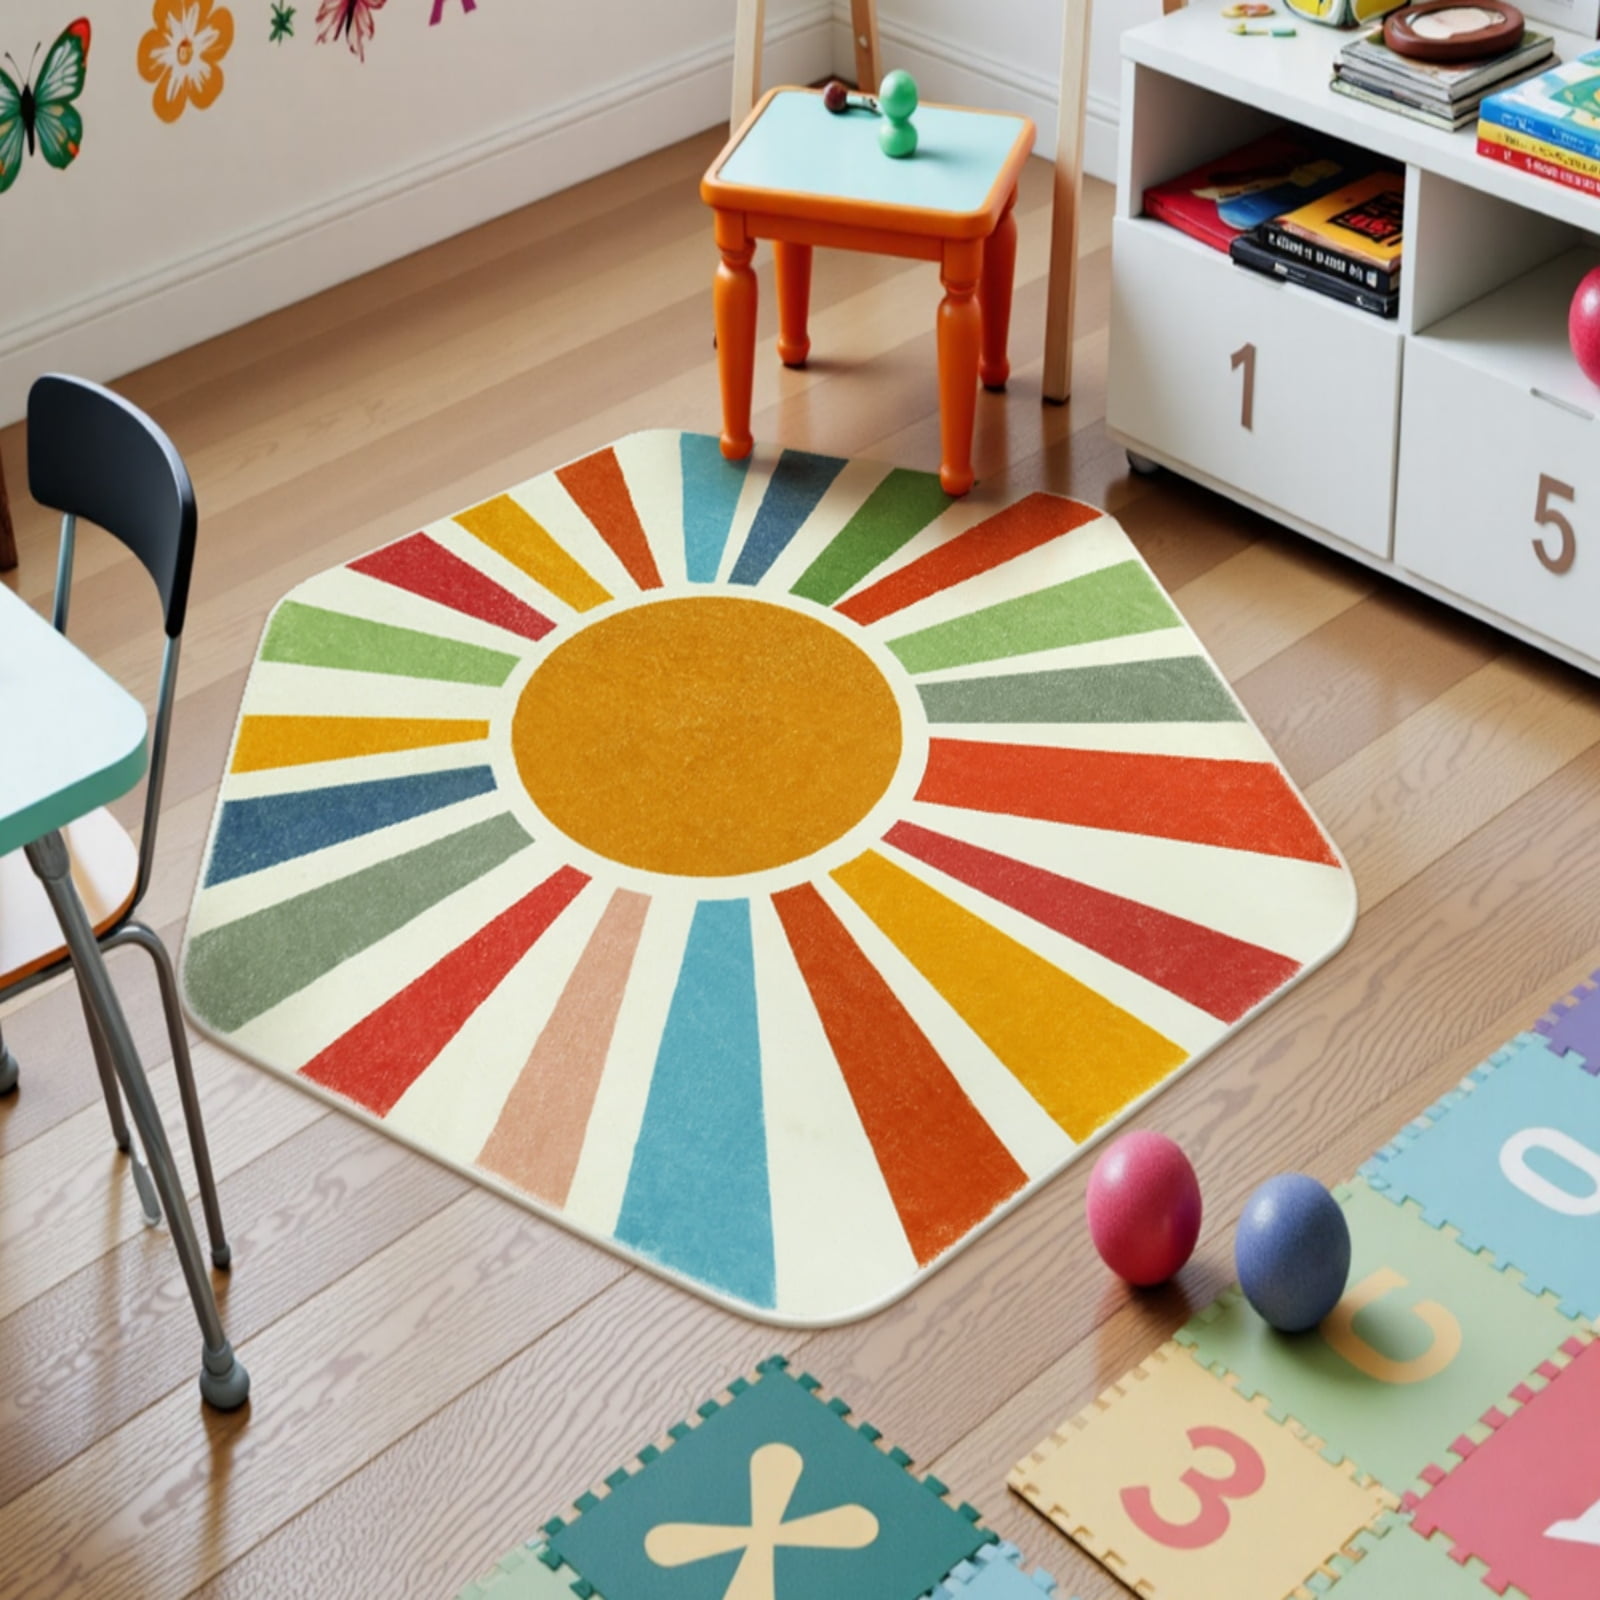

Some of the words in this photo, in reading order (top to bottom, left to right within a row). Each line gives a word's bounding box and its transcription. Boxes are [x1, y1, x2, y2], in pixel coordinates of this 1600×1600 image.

[1230, 342, 1256, 432] 1
[1532, 472, 1576, 576] 5
[1119, 1425, 1266, 1550] 3
